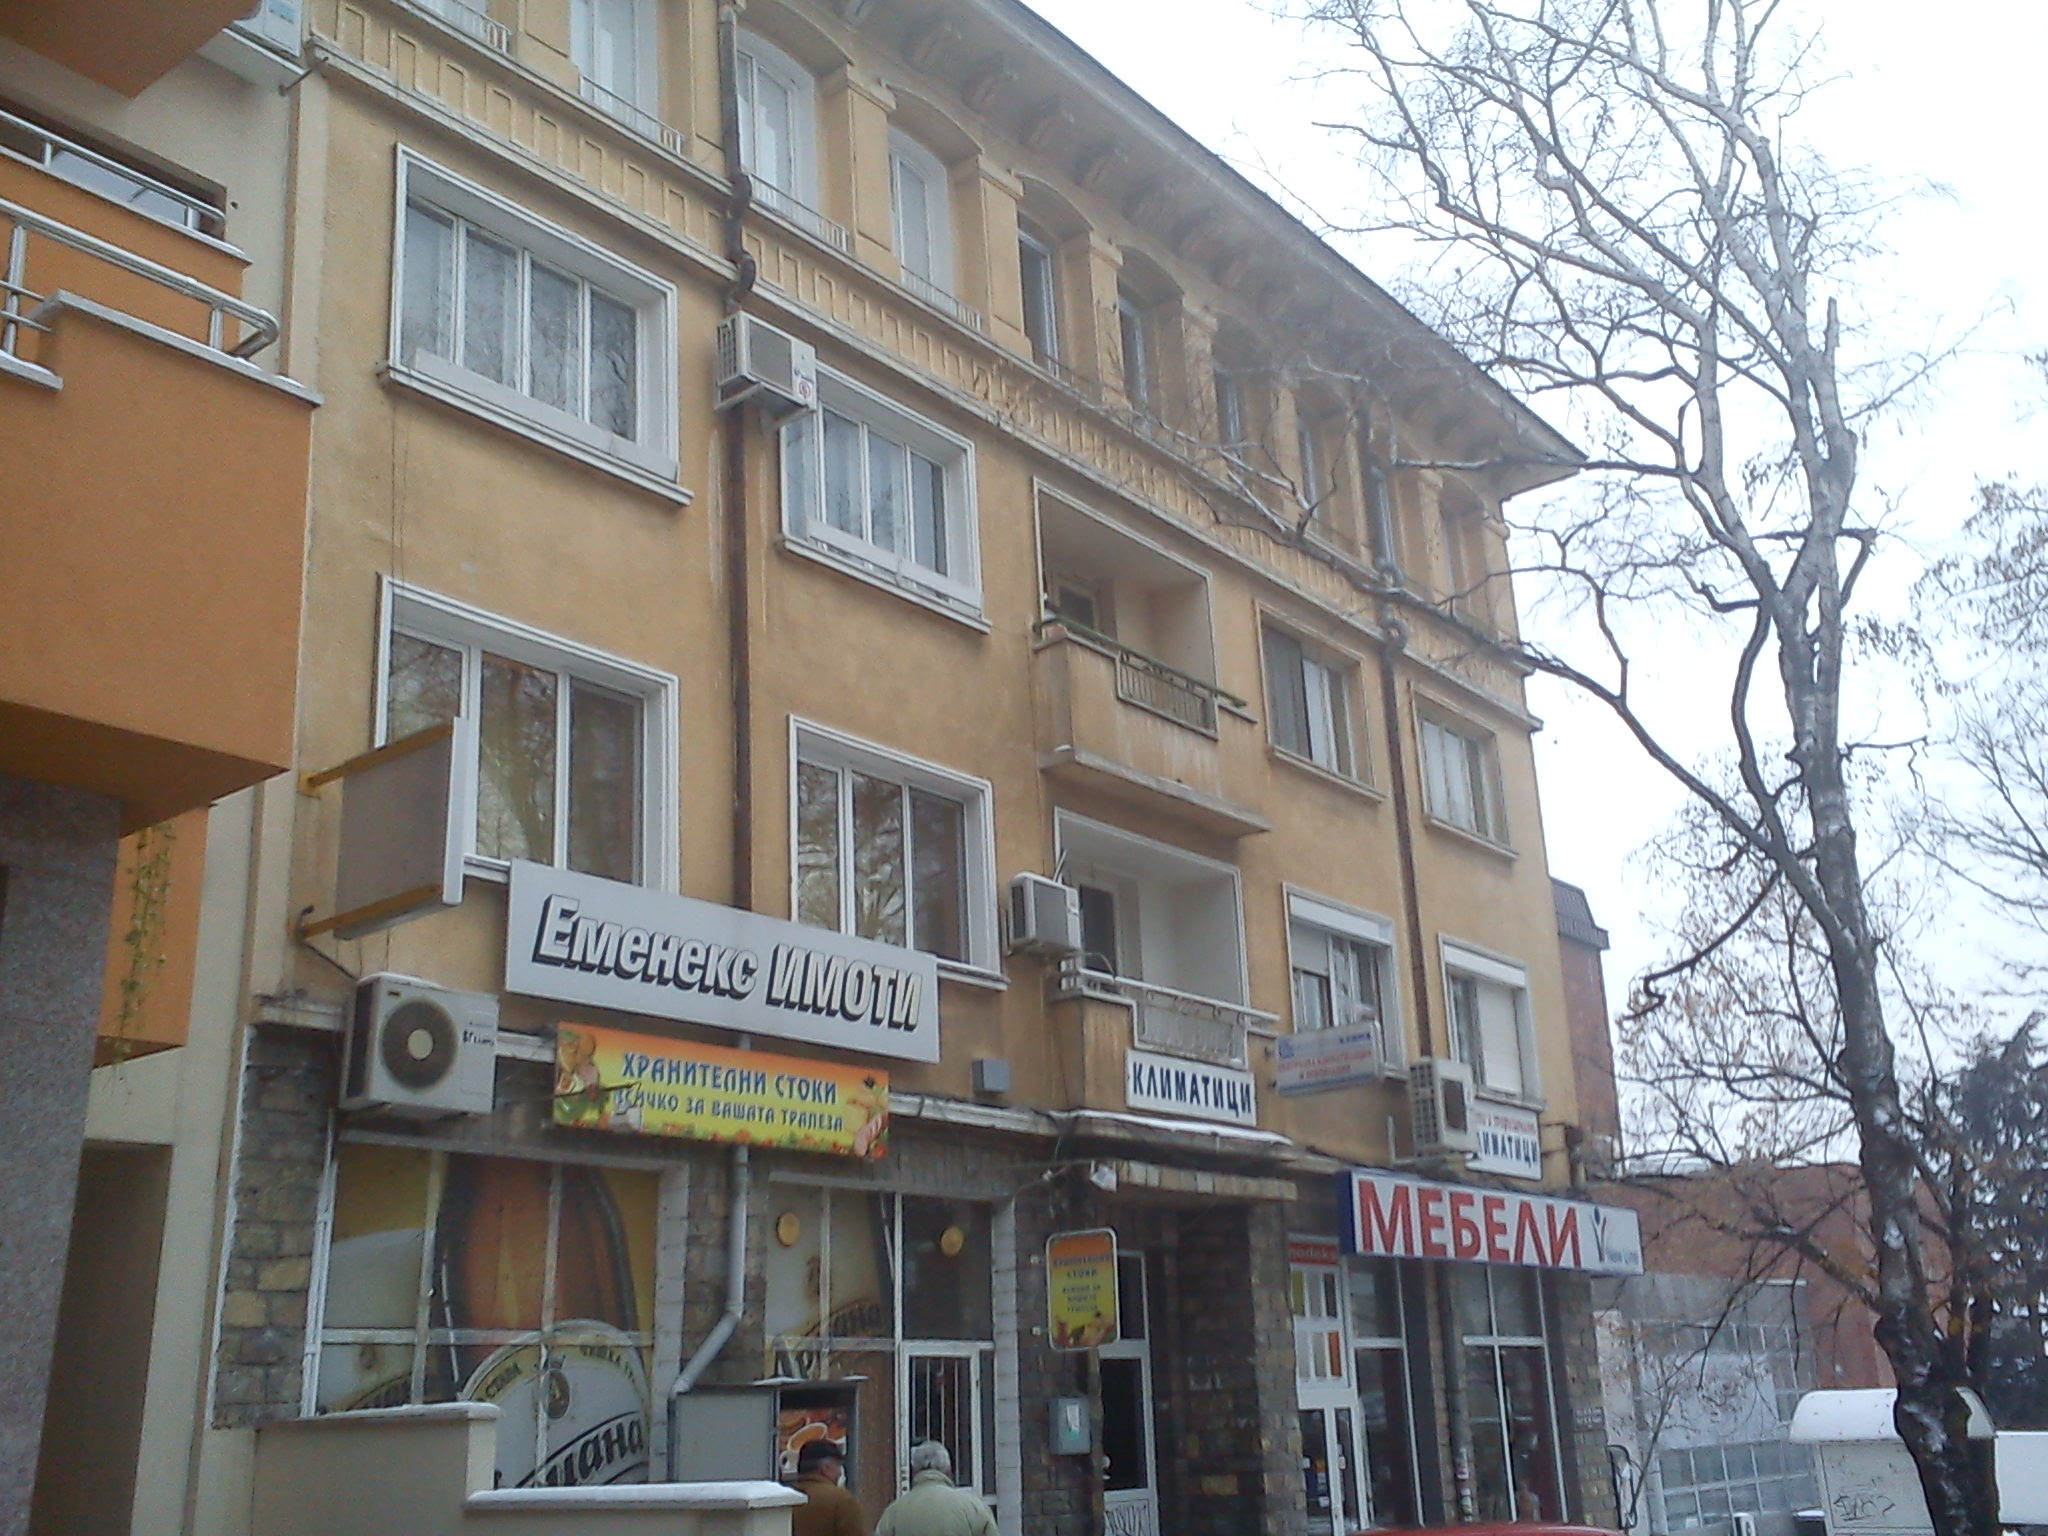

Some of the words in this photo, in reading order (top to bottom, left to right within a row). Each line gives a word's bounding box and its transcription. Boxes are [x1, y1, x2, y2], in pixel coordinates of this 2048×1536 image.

[532, 894, 759, 1000] Еменекс
[765, 943, 923, 1032] ИМОТИ
[623, 1052, 767, 1096] ХРАНИТЕЛНИ
[775, 1073, 837, 1105] СТОКИ
[1132, 1061, 1252, 1118] КЛИМАТИЦИ
[686, 1096, 705, 1116] ЗА
[711, 1099, 775, 1124] ВАШАТА
[781, 1107, 844, 1132] ТРАПЕЗА
[1358, 1179, 1582, 1268] МЕБЕЛИ
